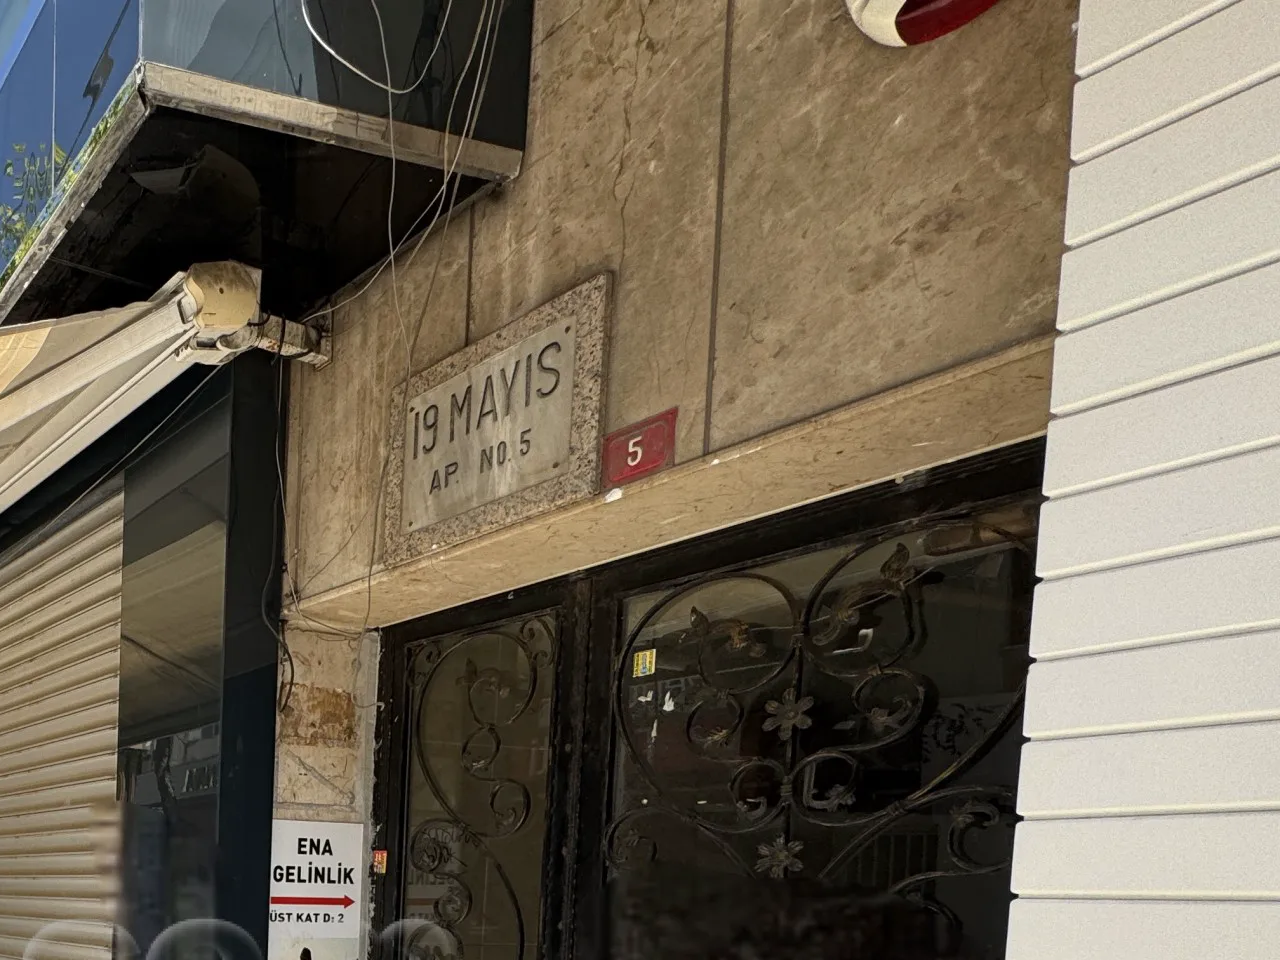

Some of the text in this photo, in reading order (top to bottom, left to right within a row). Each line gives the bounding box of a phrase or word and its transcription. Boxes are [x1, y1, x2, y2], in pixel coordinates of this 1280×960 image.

[412, 341, 562, 460] 19 MAYIS
[520, 428, 532, 457] 5
[626, 436, 643, 466] 5
[297, 837, 333, 856] ENA
[273, 861, 355, 885] GELİNLİK
[269, 910, 293, 923] ÜST
[296, 912, 321, 924] KAT
[337, 913, 345, 924] 2
